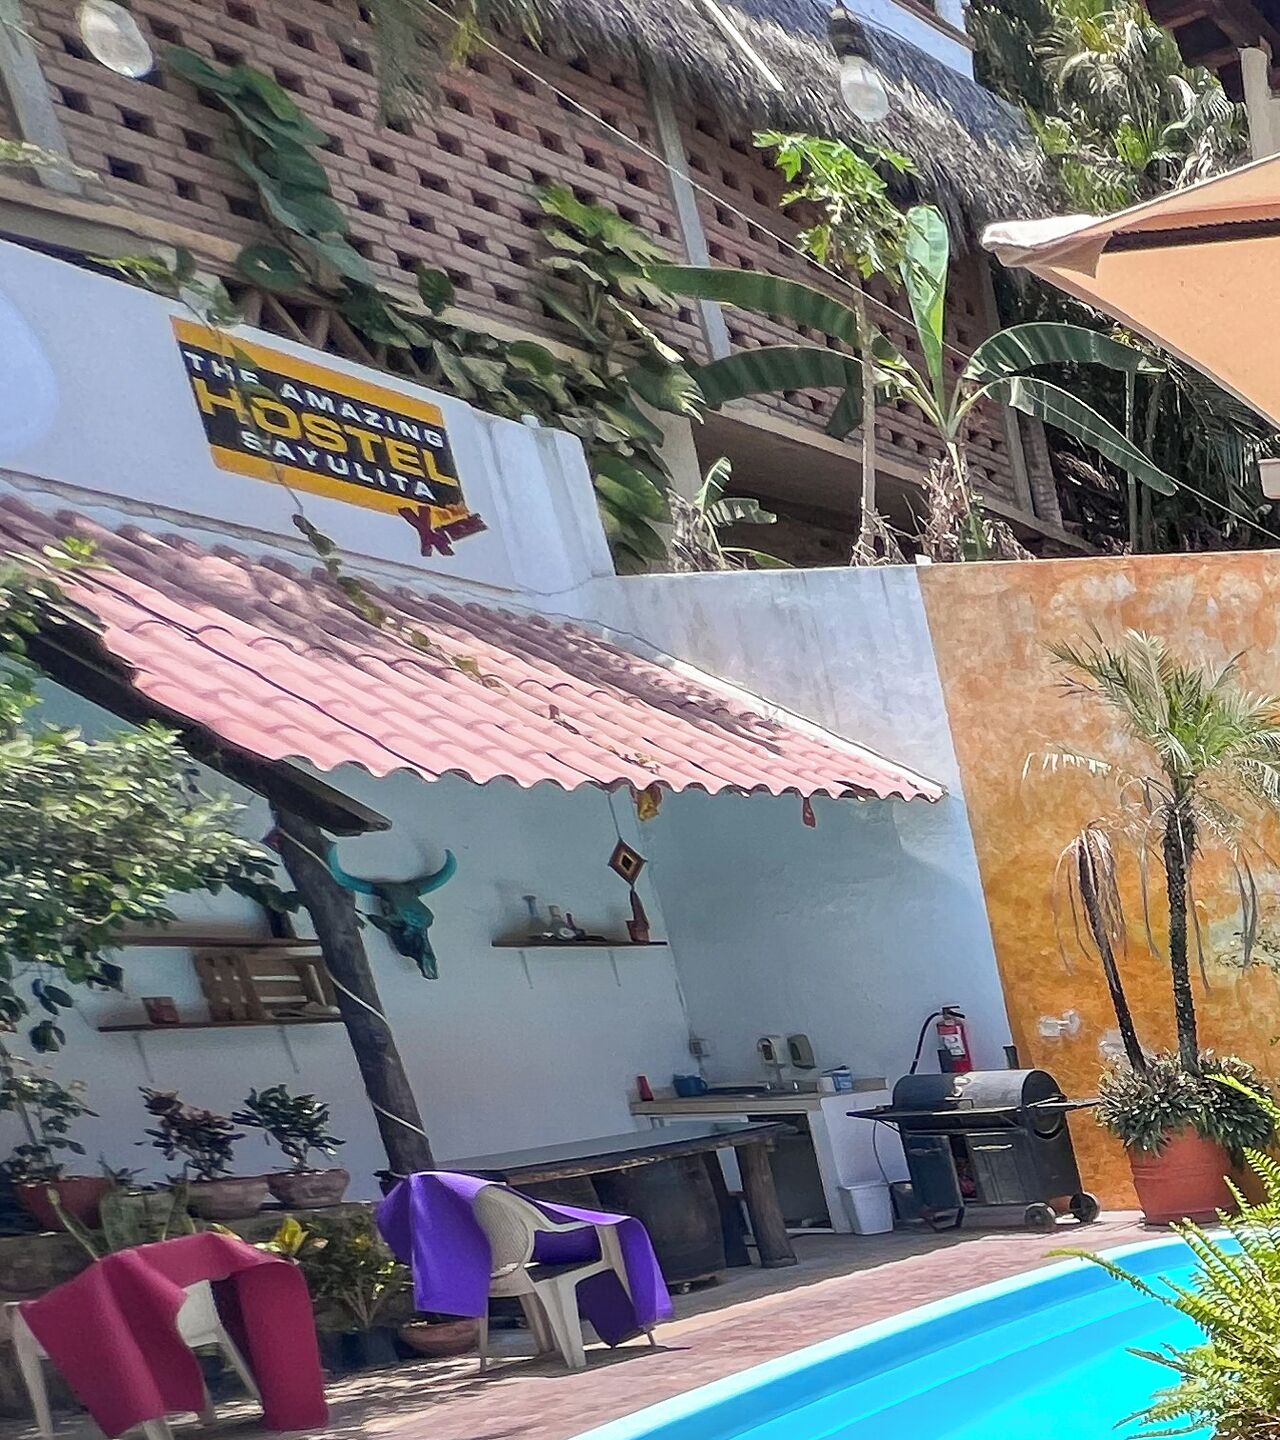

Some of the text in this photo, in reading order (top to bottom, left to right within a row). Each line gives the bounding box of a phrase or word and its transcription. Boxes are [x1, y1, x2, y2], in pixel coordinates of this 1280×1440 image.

[182, 350, 446, 449] THE AMAZING
[193, 379, 458, 488] HOSTEL
[240, 430, 438, 502] SAYULITA
